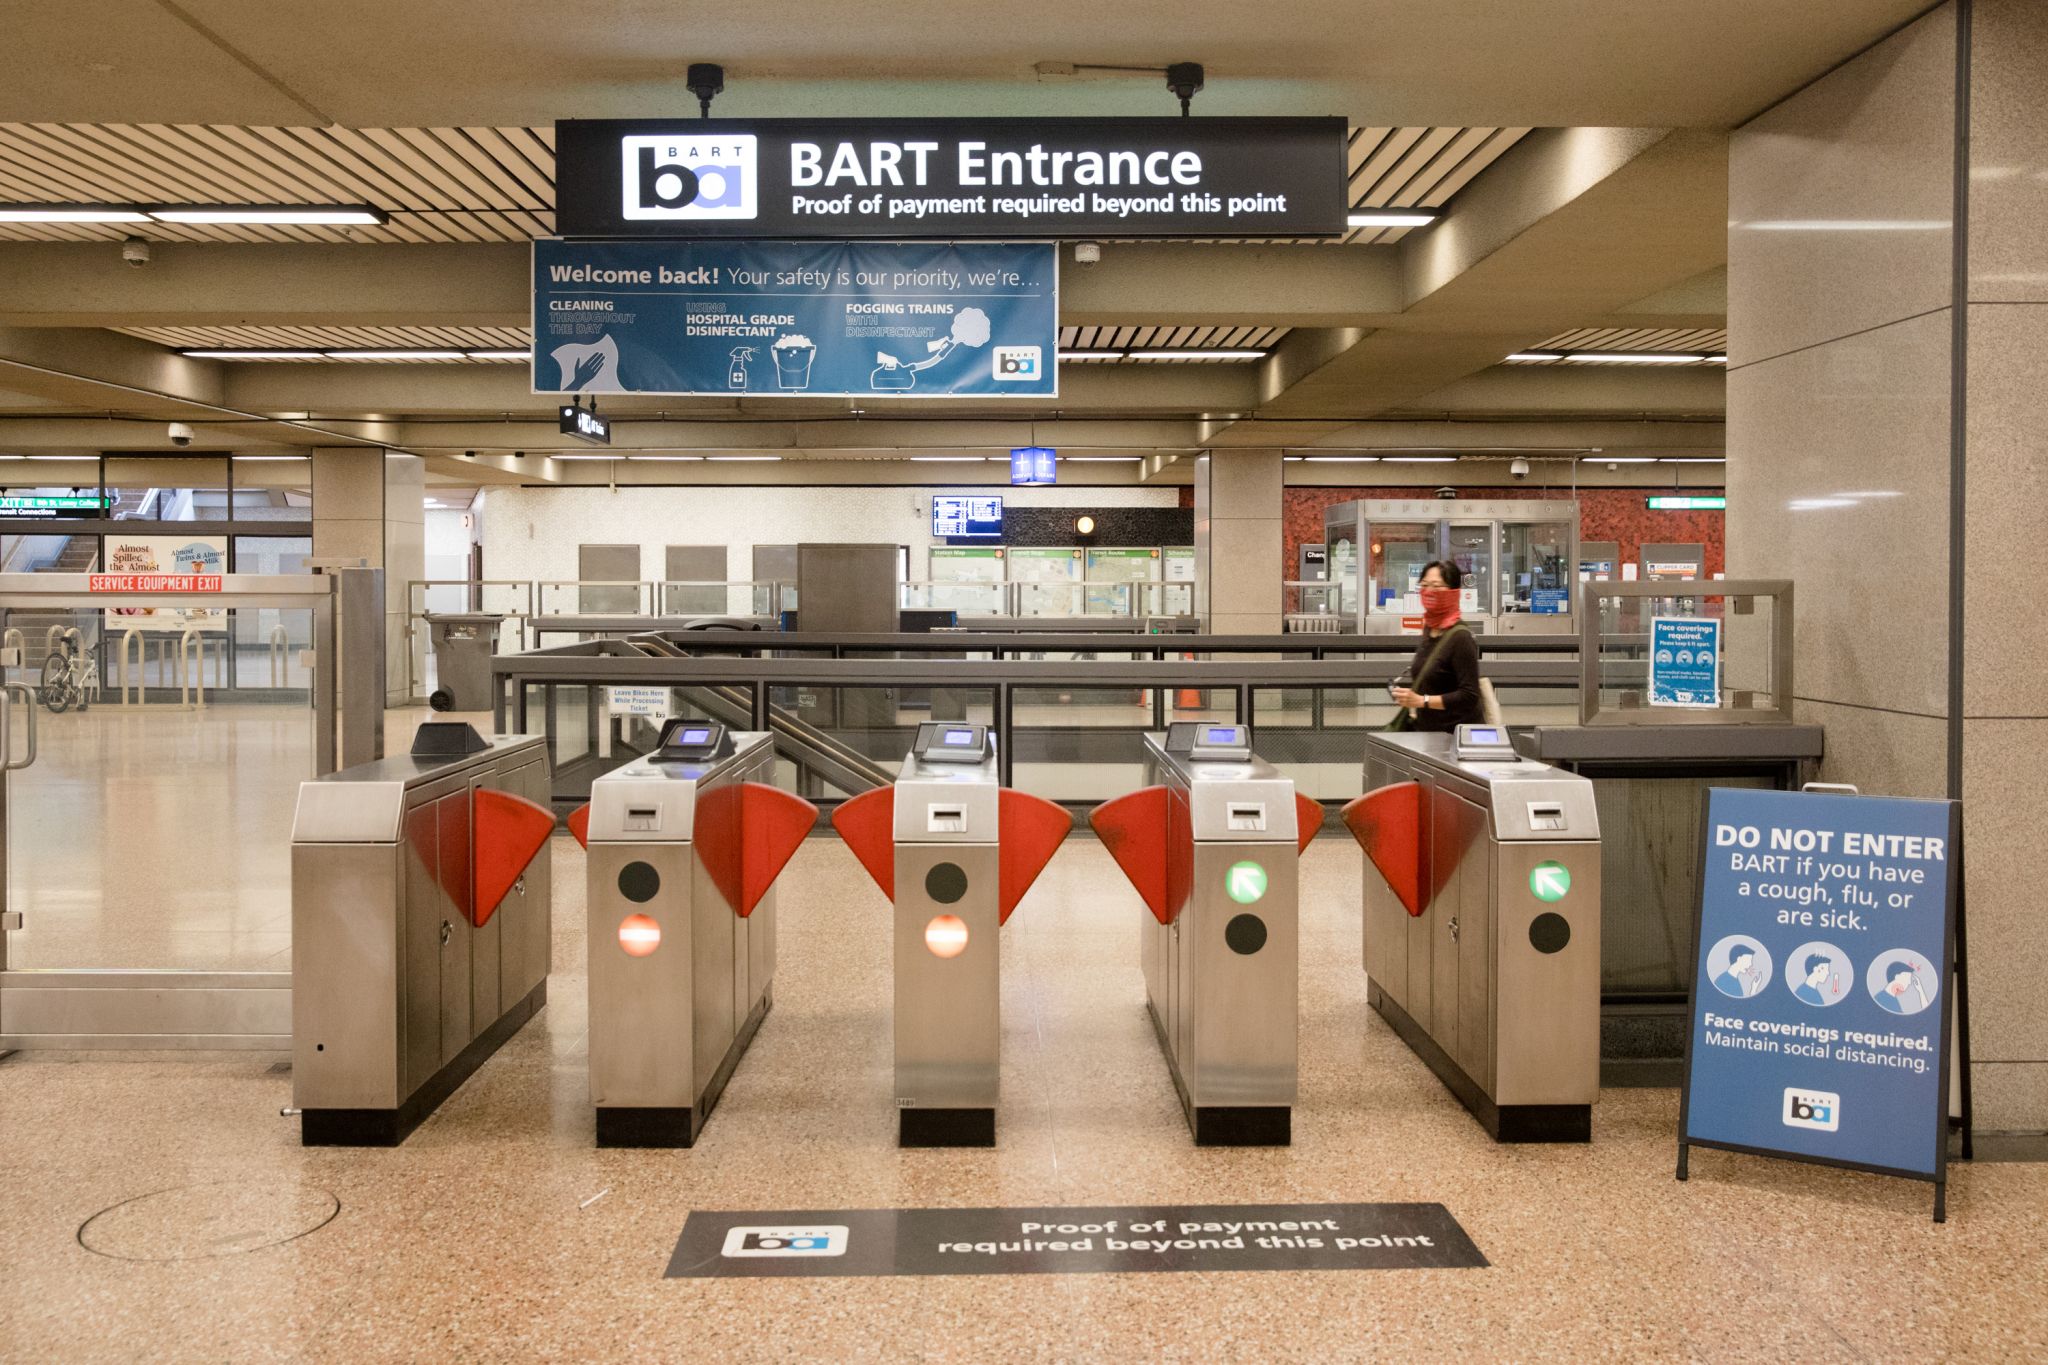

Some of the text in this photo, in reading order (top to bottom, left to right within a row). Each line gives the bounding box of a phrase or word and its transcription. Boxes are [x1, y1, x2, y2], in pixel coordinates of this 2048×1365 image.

[668, 146, 742, 157] BART
[791, 141, 1202, 186] BART Entrance
[792, 193, 1286, 218] Proof of payment required beyond this point
[550, 265, 651, 284] Welcome
[659, 266, 719, 285] back!
[727, 267, 770, 285] Your
[776, 267, 831, 290] safety
[837, 268, 850, 286] is
[856, 271, 887, 286] our
[894, 269, 960, 290] priority,
[549, 301, 614, 311] CLEANING
[686, 302, 727, 314] USING
[846, 303, 954, 314] FOGGING TRAINS
[549, 312, 636, 324] THROUGHOUT
[686, 314, 795, 326] HOSPITAL GRADE
[846, 315, 878, 326] WITH
[549, 324, 602, 335] THE DAY
[686, 326, 776, 337] DISINFECTANT
[846, 327, 935, 338] DISINFECTANT
[0, 498, 20, 508] XIT
[119, 544, 149, 553] Almost
[171, 548, 194, 556] Almost
[203, 550, 225, 559] Almost
[110, 562, 160, 571] the Almost
[204, 557, 219, 565] Milk
[92, 577, 220, 590] SERVICE EQUIPMENT EXIT
[1676, 625, 1713, 633] coverings
[1716, 824, 1944, 860] DO NOT ENTER
[1731, 853, 1925, 883] BART if you have
[1738, 882, 1913, 909] a cough, flu, or
[1777, 909, 1867, 930] are sick.
[1704, 1012, 1933, 1052] Face coverings required.
[1705, 1031, 1930, 1073] Maintain social distancing.
[1021, 1219, 1340, 1235] Proof of payment
[938, 1234, 1435, 1255] required beyond this point
